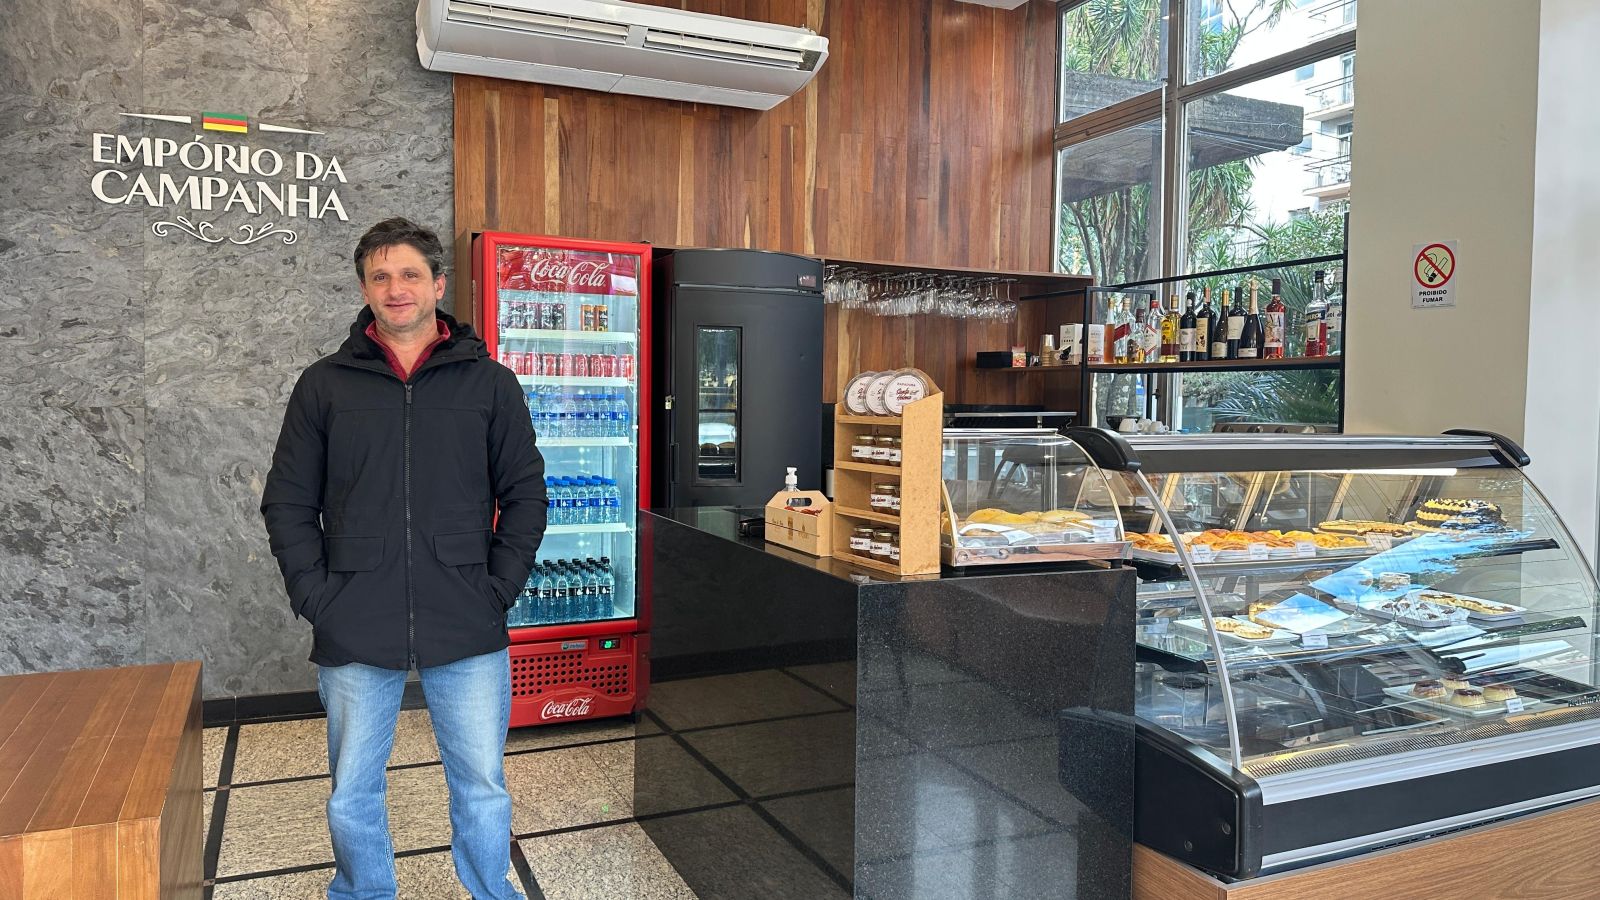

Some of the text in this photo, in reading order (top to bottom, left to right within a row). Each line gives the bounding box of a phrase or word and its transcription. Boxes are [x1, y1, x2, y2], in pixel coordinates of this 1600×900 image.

[92, 132, 348, 183] EMPÓRIO DA
[90, 169, 349, 221] CAMPANHA
[530, 258, 610, 287] Coca-Cola
[541, 697, 592, 720] Coca-Cola
